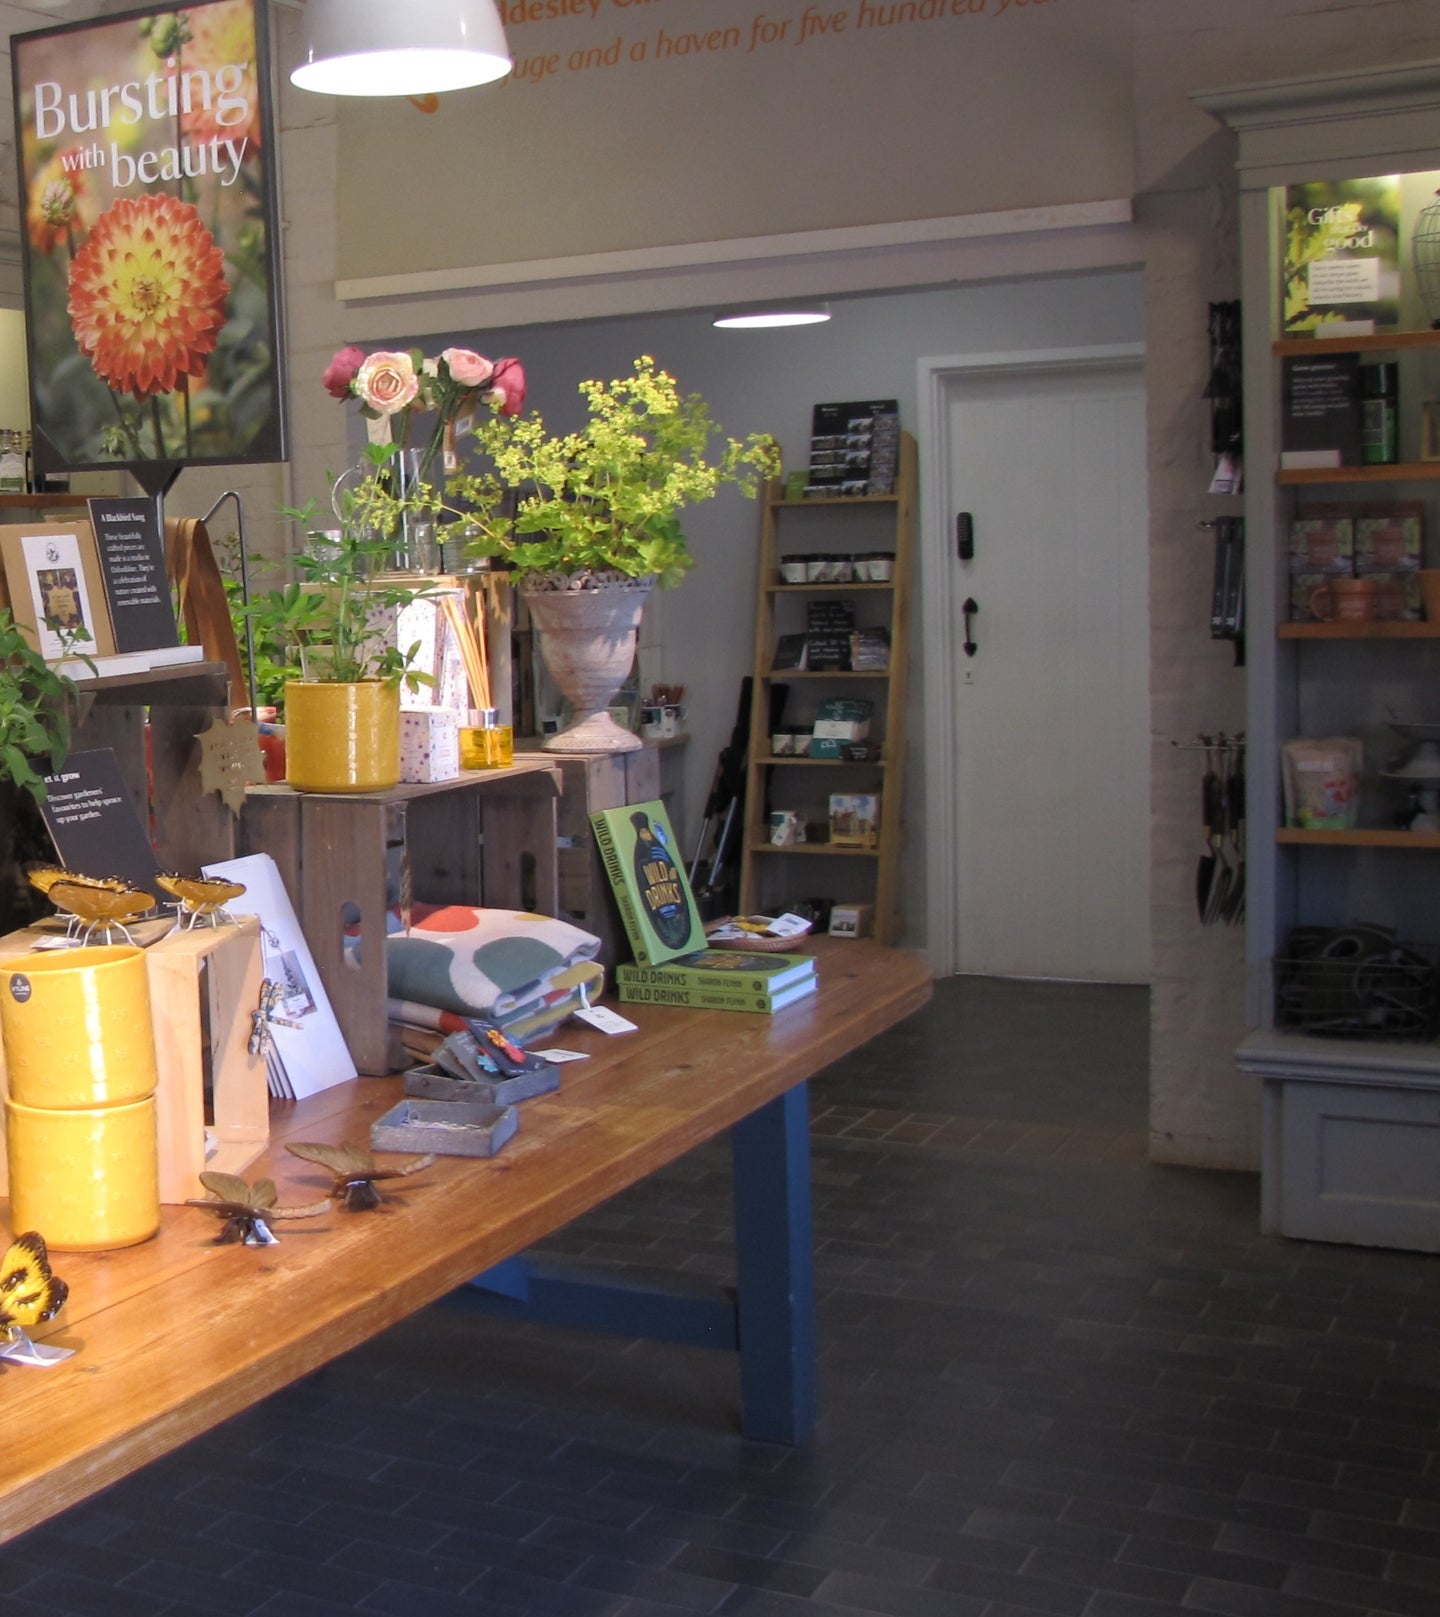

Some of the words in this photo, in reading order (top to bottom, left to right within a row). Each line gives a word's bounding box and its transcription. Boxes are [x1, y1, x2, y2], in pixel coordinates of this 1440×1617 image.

[568, 37, 624, 71] and
[630, 41, 647, 62] a
[655, 29, 741, 58] haven
[747, 15, 793, 54] for
[794, 7, 848, 46] five
[34, 57, 249, 139] Bursting
[61, 143, 105, 172] with
[111, 135, 249, 188] beauty
[60, 772, 80, 783] grow
[47, 794, 73, 802] Discover
[51, 803, 81, 813] favourites
[88, 799, 102, 807] help
[102, 797, 122, 806] spruce
[65, 815, 79, 823] your
[595, 818, 611, 846] WILD
[603, 847, 625, 887] DRINKS
[642, 860, 669, 885] WILD
[645, 882, 681, 911] DRINKS
[623, 969, 647, 983] WILD
[650, 971, 687, 986] DRINKS
[626, 987, 651, 1001] WILD
[653, 989, 690, 1004] DRINKS
